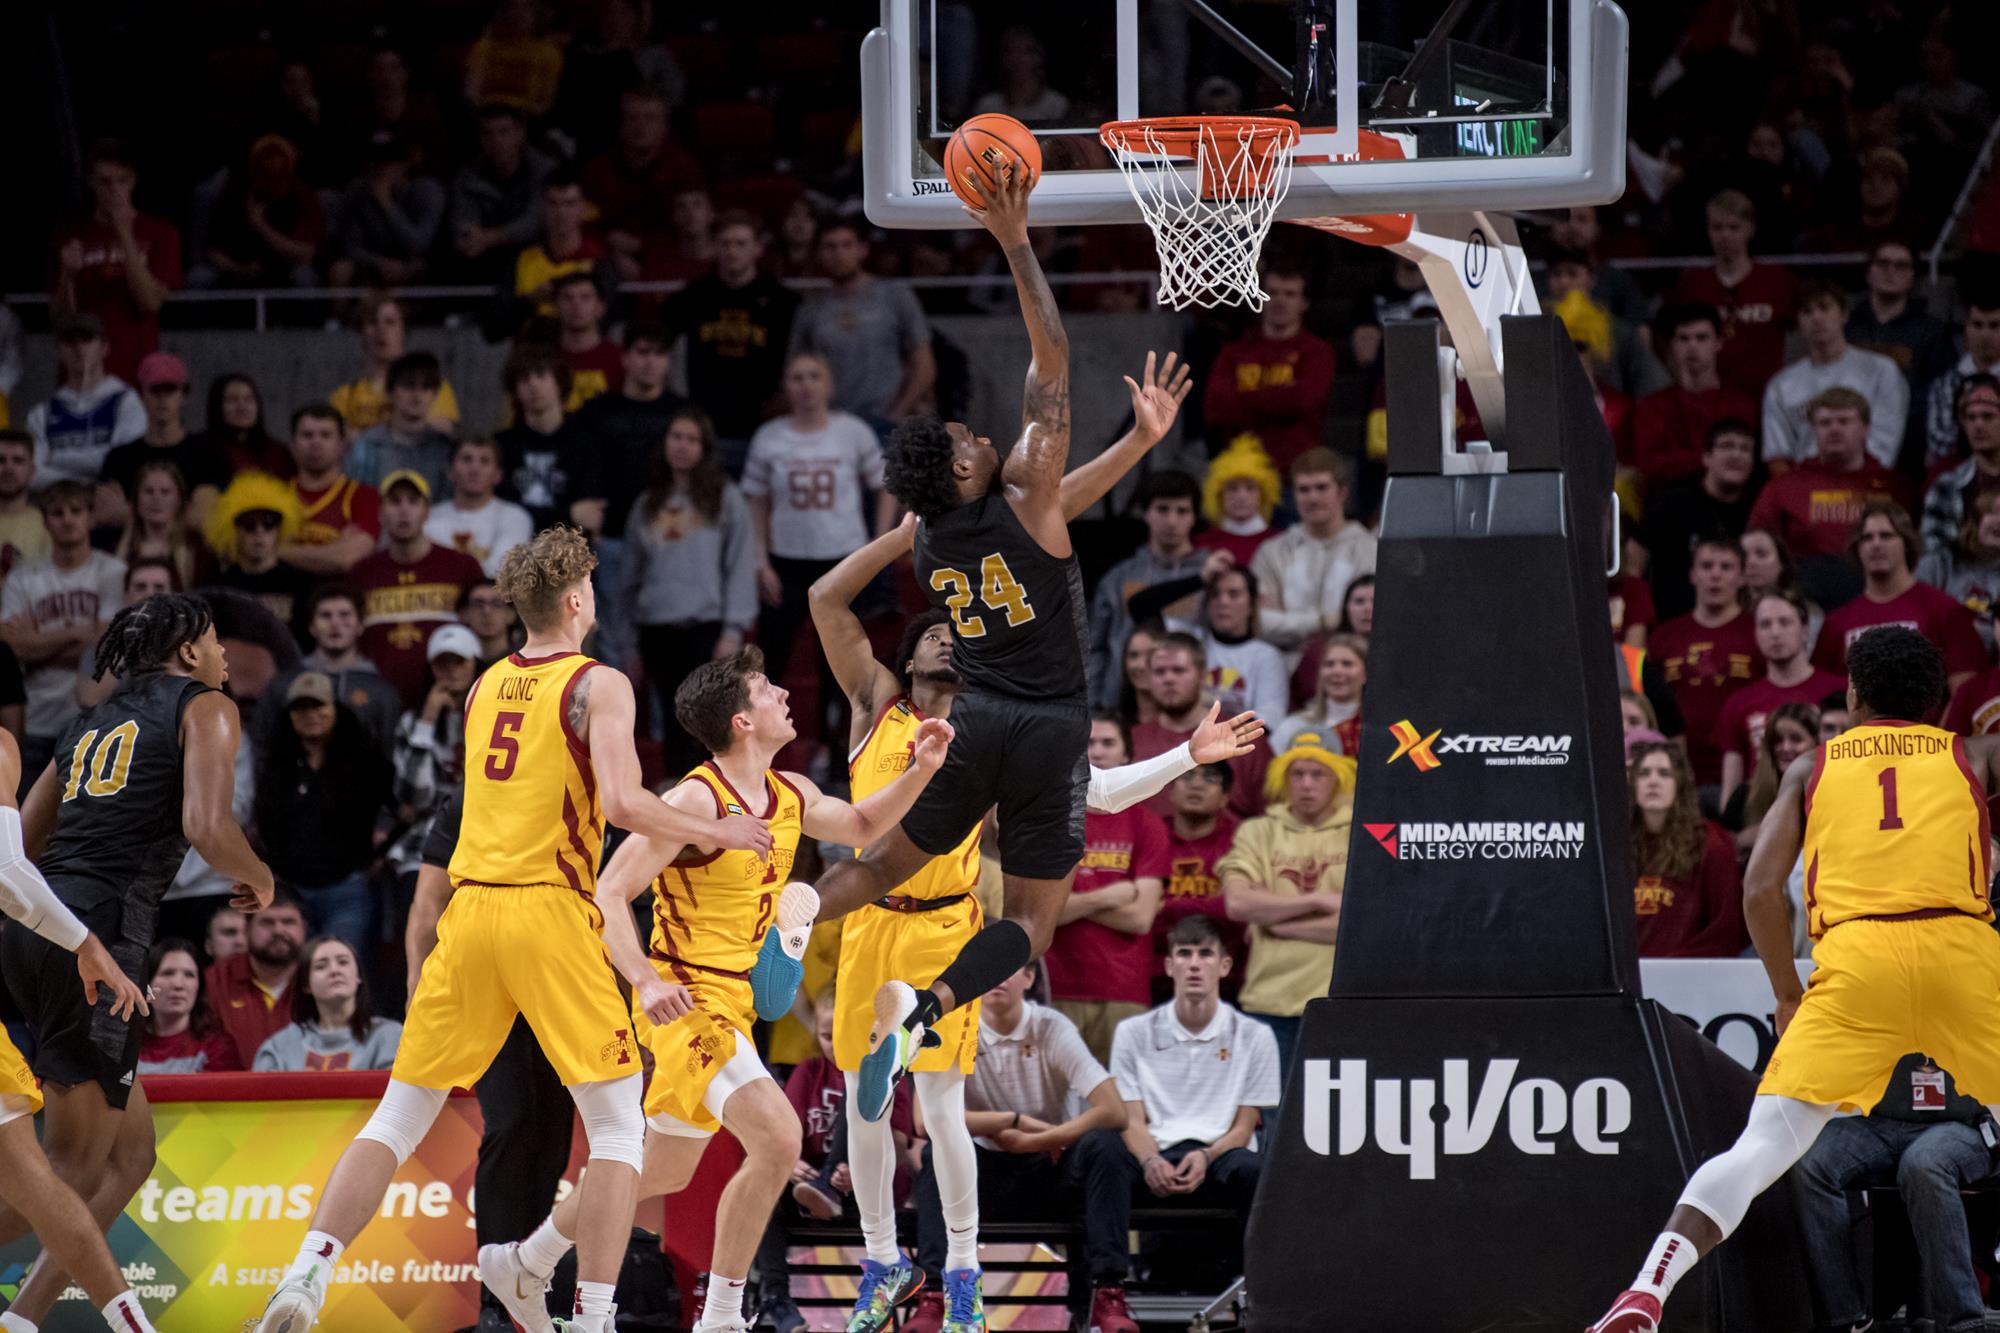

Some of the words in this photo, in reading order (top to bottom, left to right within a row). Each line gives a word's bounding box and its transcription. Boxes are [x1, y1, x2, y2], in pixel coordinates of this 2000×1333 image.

[929, 552, 1036, 638] 24
[497, 676, 539, 701] KUNC
[484, 711, 525, 781] 5
[1438, 734, 1572, 754] XTREAM
[1830, 733, 1948, 760] BROCKINGTON
[62, 720, 140, 803] 10
[1517, 755, 1565, 766] Mediacom
[1878, 767, 1904, 830] 1
[1400, 822, 1585, 843] MIDAMERICAN
[1400, 843, 1476, 860] ENERGY
[1481, 842, 1585, 860] COMPANY
[1634, 886, 1675, 907] TATE
[751, 893, 773, 943] 2
[139, 1178, 314, 1223] teams
[380, 1180, 453, 1218] ne
[208, 1263, 229, 1287] A
